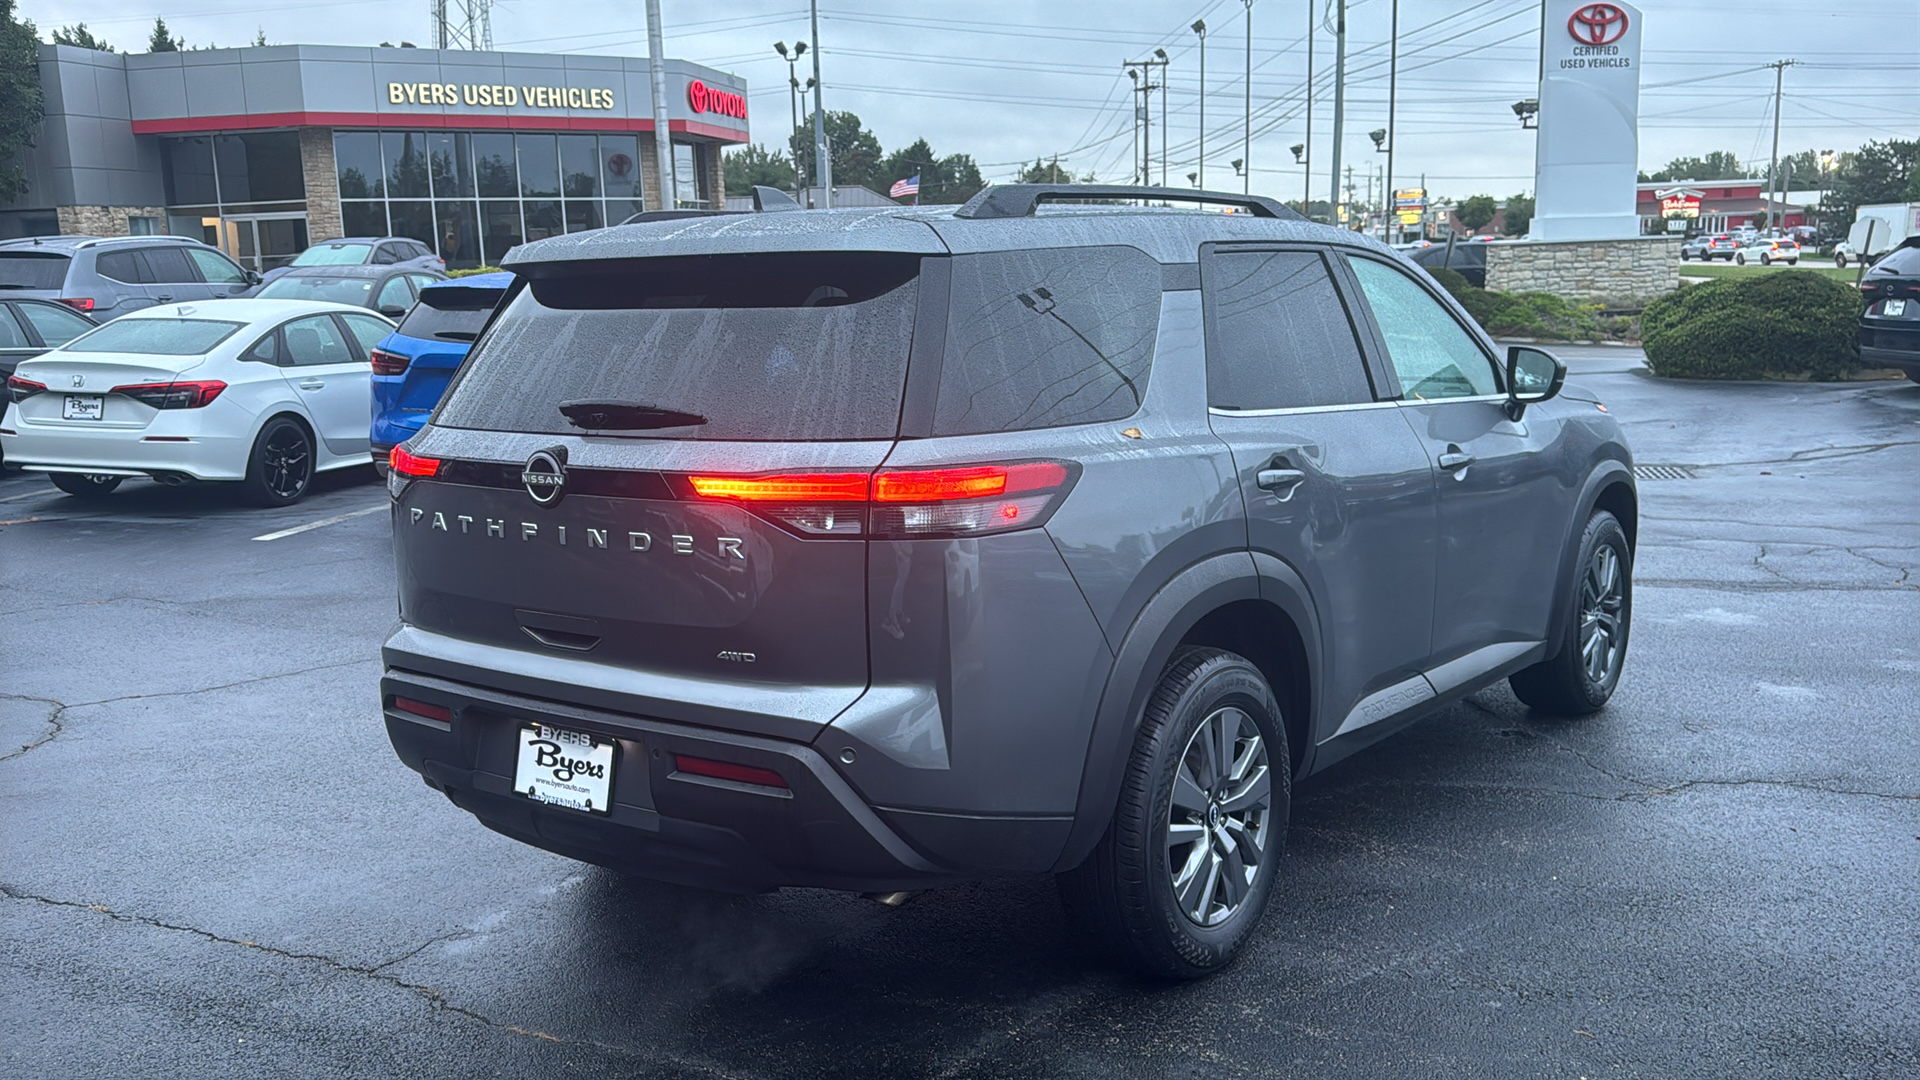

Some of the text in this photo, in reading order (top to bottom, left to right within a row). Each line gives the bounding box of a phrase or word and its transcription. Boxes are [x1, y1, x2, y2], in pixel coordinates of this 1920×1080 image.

[1573, 45, 1619, 56] CERTIFIED
[1560, 57, 1630, 69] USED VEHICLES
[388, 82, 614, 110] BYERS USED VEHICLES
[707, 87, 748, 120] TOYOTA
[522, 473, 563, 485] NISSAN
[410, 507, 745, 560] PATHFINDER
[716, 650, 756, 662] 4WD
[541, 725, 591, 748] BYERS
[528, 739, 604, 782] Byers
[535, 777, 591, 794] www.byersauto.com
